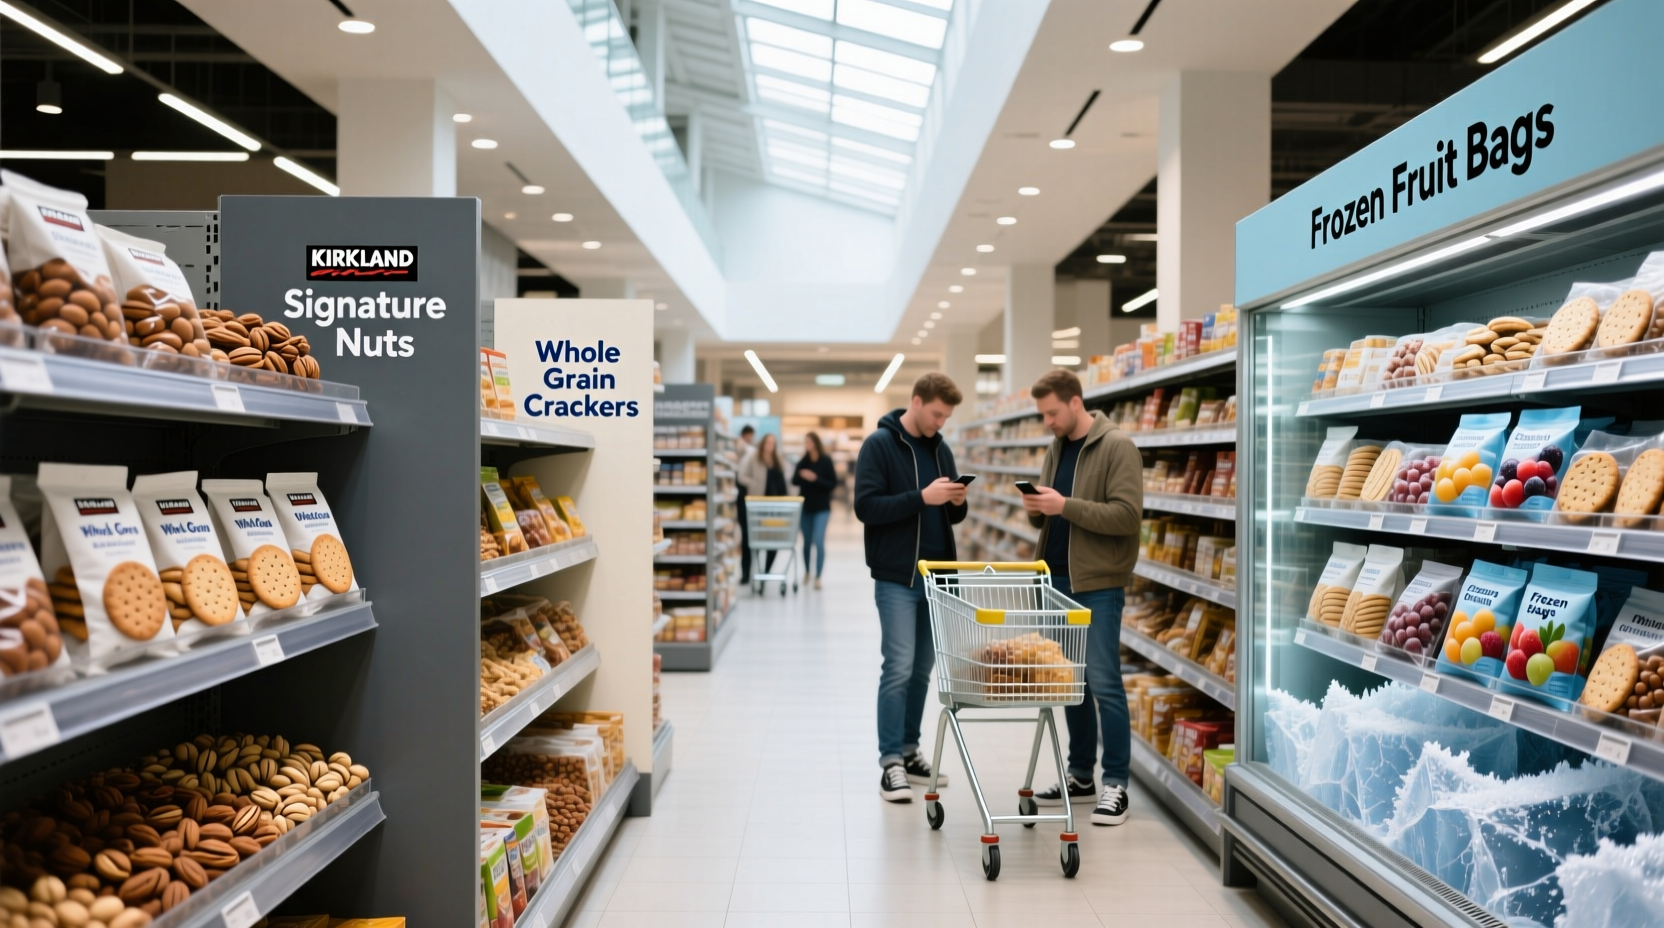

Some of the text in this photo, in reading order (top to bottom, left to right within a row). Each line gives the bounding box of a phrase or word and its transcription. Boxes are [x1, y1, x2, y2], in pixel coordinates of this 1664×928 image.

[1311, 103, 1555, 249] Frozen Fruit Bags
[311, 249, 414, 268] KIRKLAND
[284, 288, 447, 327] Signature
[336, 327, 414, 358] Nuts
[535, 340, 621, 363] Whole
[543, 367, 615, 390] Grain
[523, 393, 639, 417] Crackers
[1530, 592, 1568, 609] Frozen
